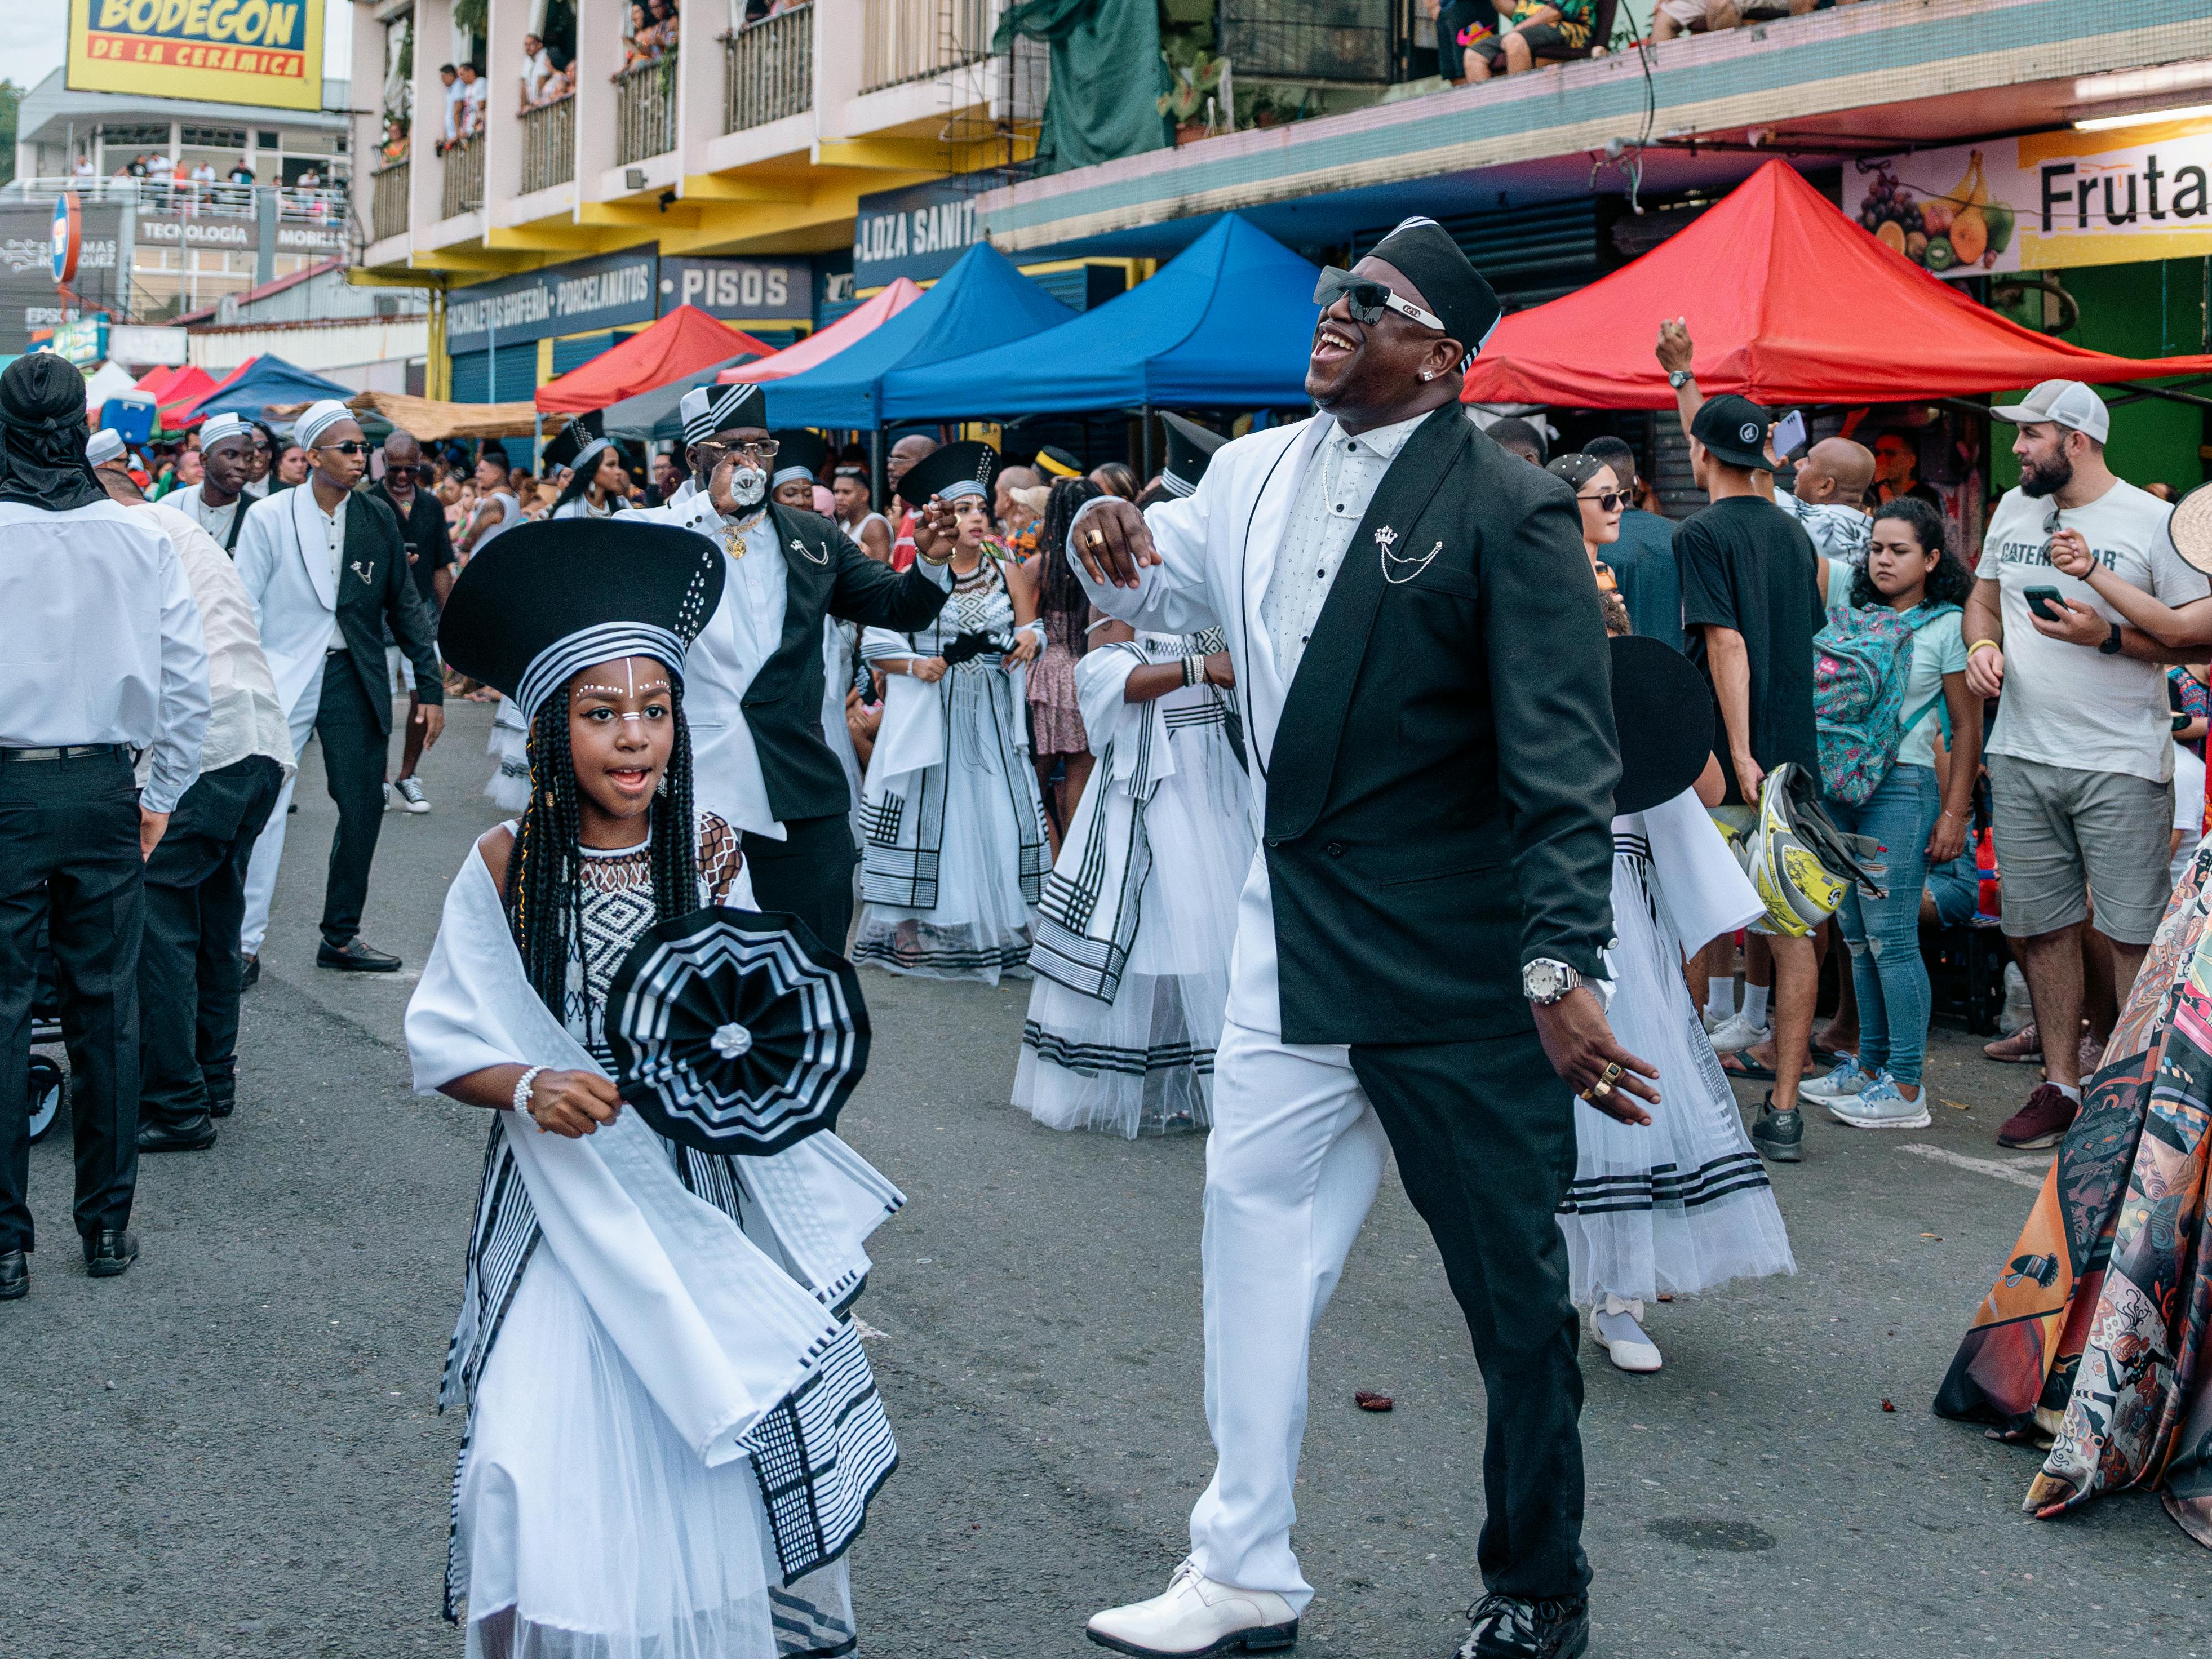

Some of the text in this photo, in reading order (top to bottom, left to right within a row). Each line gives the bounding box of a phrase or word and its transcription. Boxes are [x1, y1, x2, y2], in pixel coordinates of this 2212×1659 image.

[92, 38, 300, 76] DE LA CERÁMICA
[2041, 154, 2208, 232] Fruta
[144, 222, 248, 244] TECNOLOGÍA
[862, 212, 908, 263] LOZA
[556, 264, 648, 317] PORCELANATOS
[682, 268, 789, 306] PISOS
